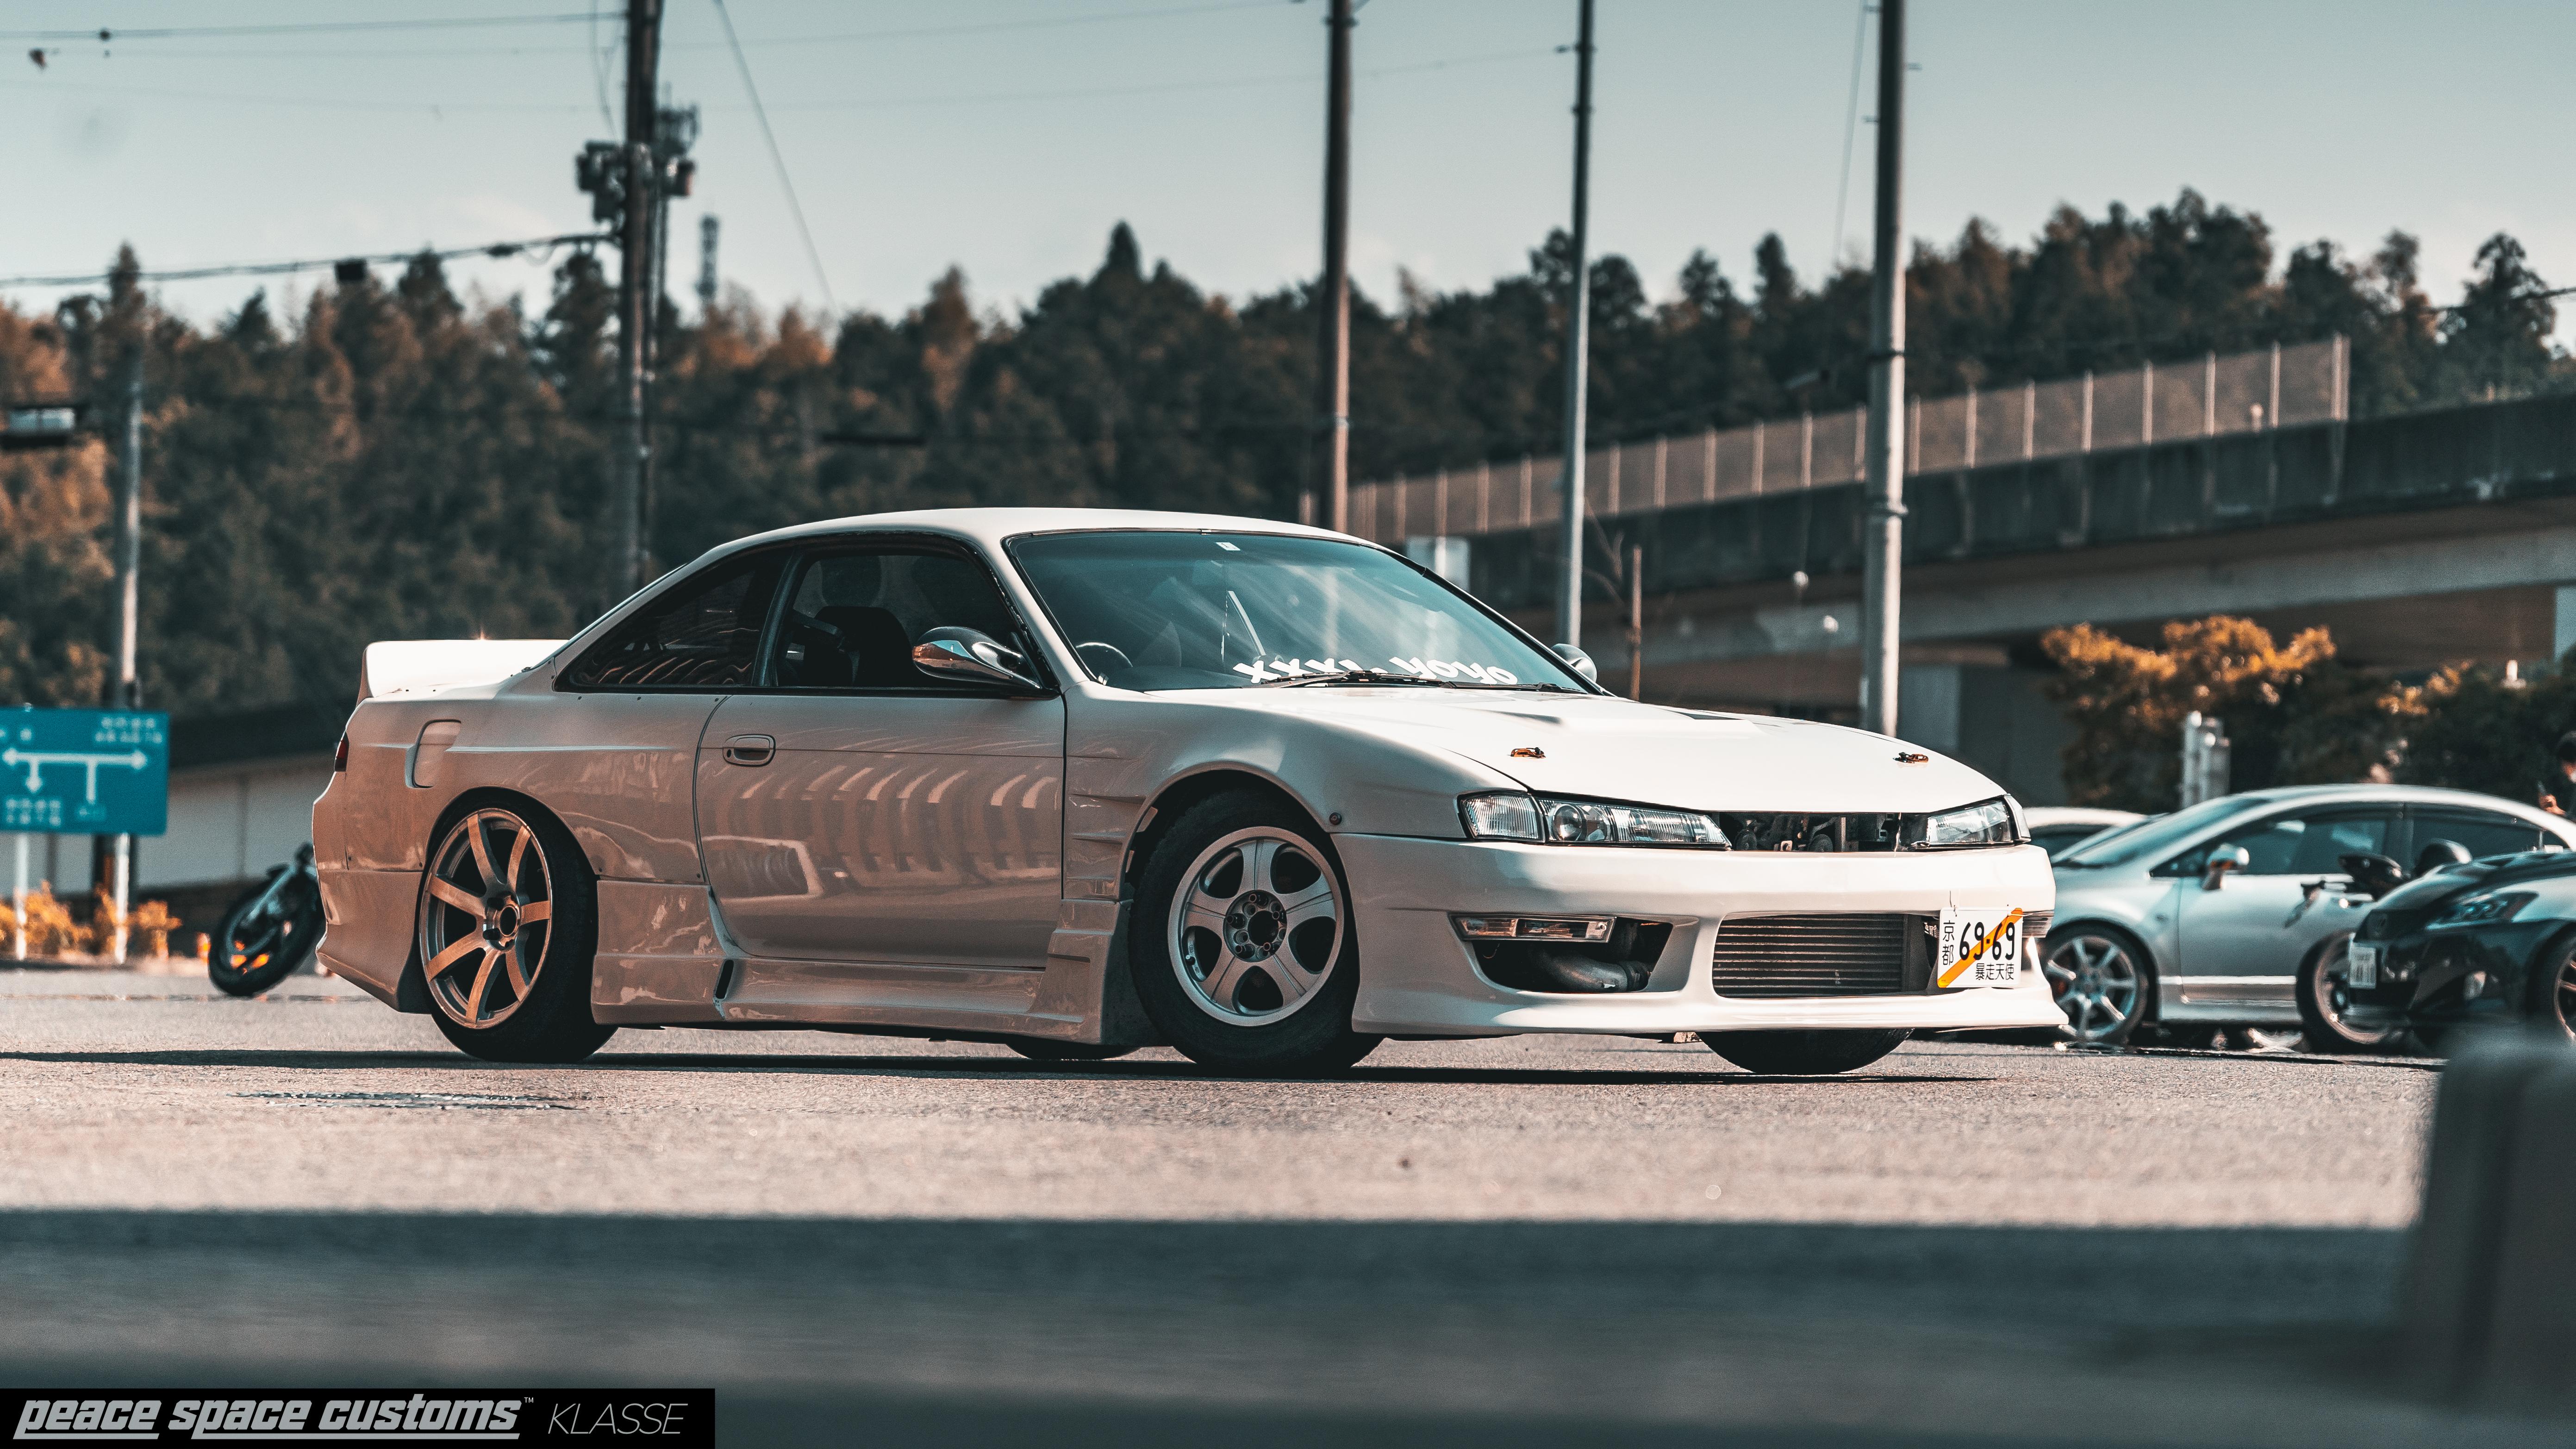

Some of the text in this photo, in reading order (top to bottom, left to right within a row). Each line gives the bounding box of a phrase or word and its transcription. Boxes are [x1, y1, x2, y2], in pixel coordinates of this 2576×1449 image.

[1942, 920, 1955, 966] 京都
[1975, 962, 2015, 981] 暴走天使
